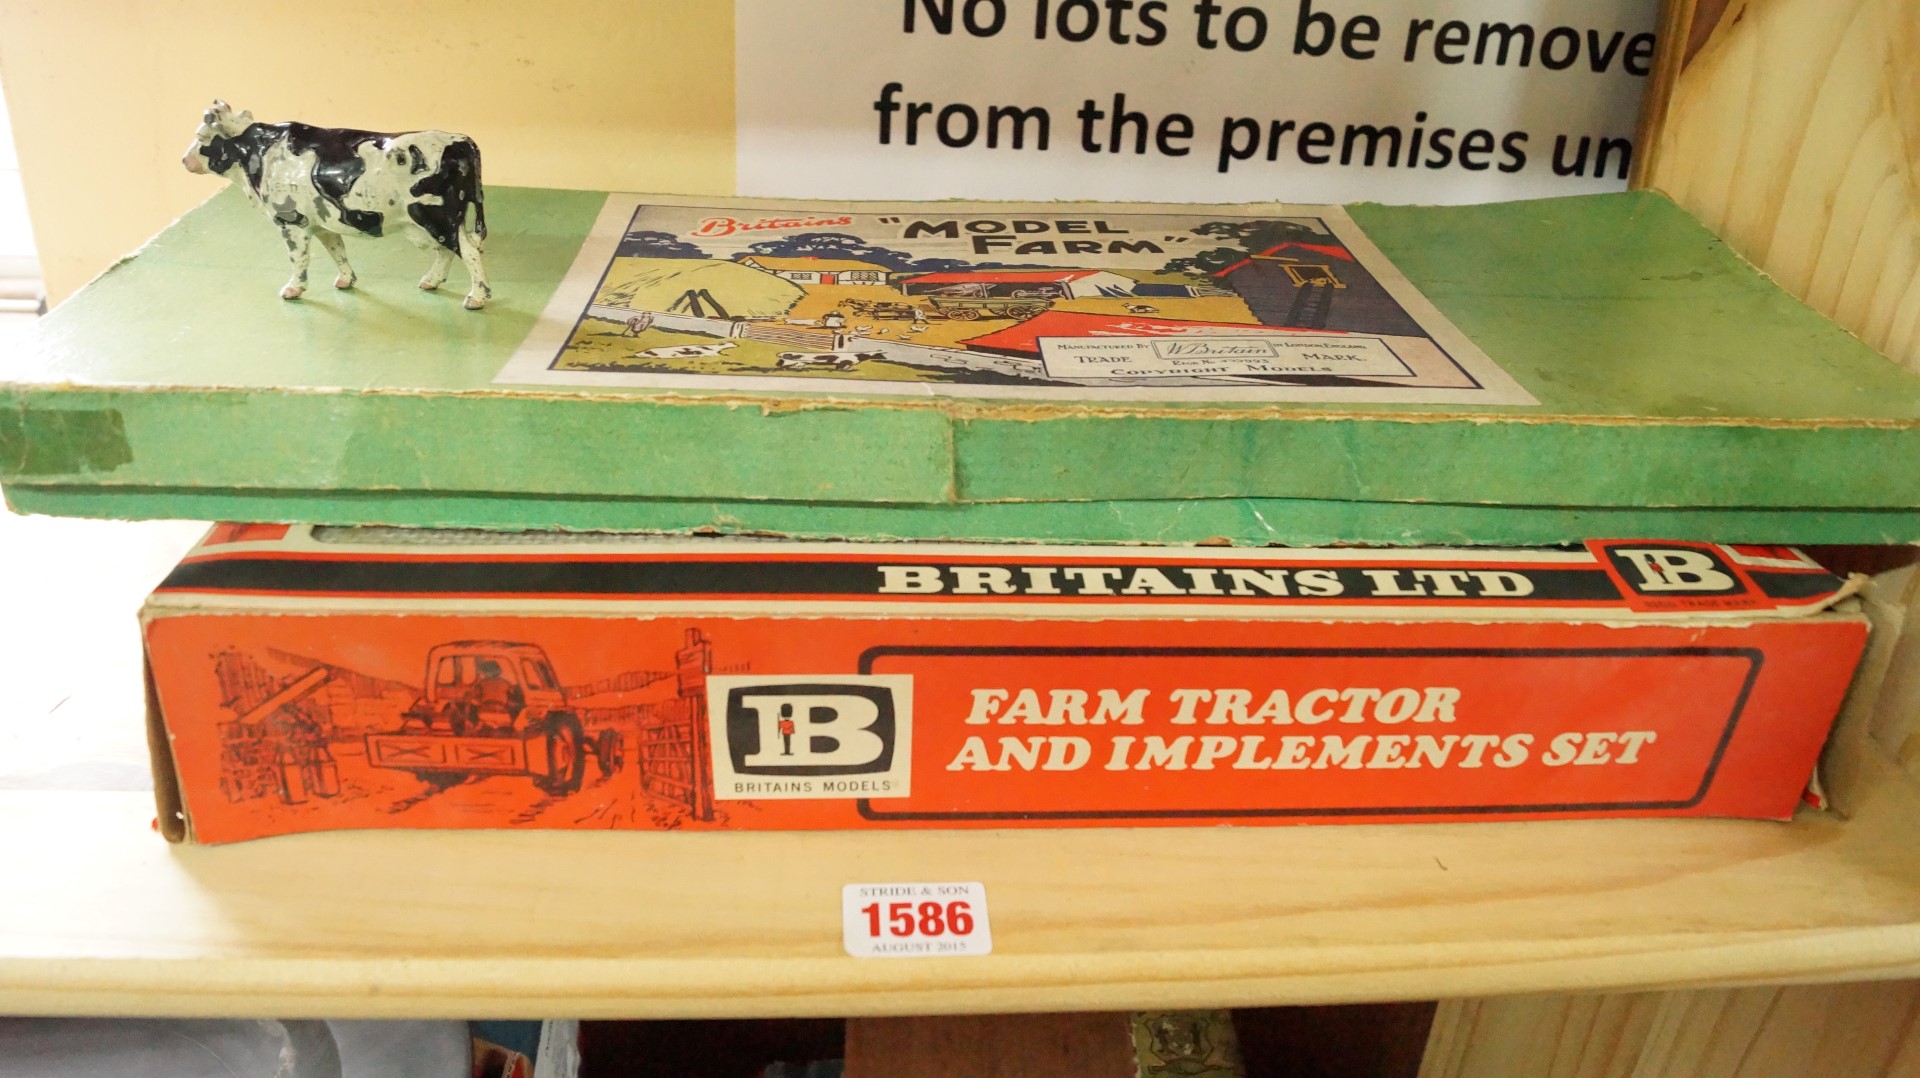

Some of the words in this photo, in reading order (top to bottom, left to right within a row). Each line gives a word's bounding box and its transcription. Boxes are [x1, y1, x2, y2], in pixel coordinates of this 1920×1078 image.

[903, 0, 1007, 38] No
[1034, 0, 1168, 47] lots
[1194, 0, 1269, 52] to
[1293, 0, 1381, 60] be
[1403, 18, 1656, 77] remove
[873, 82, 1050, 151] from
[1077, 92, 1194, 157] the
[1217, 111, 1529, 174] premises
[1551, 133, 1633, 180] un
[690, 216, 853, 237] Britains
[1074, 356, 1132, 364] TRADE
[1110, 366, 1231, 376] COPYRIGHT
[1246, 364, 1333, 373] MODELS
[877, 565, 1345, 597] BRITAINS
[1362, 569, 1535, 597] LTD
[964, 688, 1152, 726] FARM
[1169, 686, 1462, 726] TRACTOR
[945, 735, 1092, 772] AND
[1103, 733, 1535, 771] IMPLEMENTS
[1541, 731, 1658, 767] SET
[734, 781, 813, 794] BRITAINS
[822, 780, 892, 792] MODELS
[859, 887, 916, 897] STRIDE
[920, 887, 932, 896] &
[937, 885, 970, 896] SON
[860, 901, 974, 938] 1586
[871, 943, 932, 953] AUGUST
